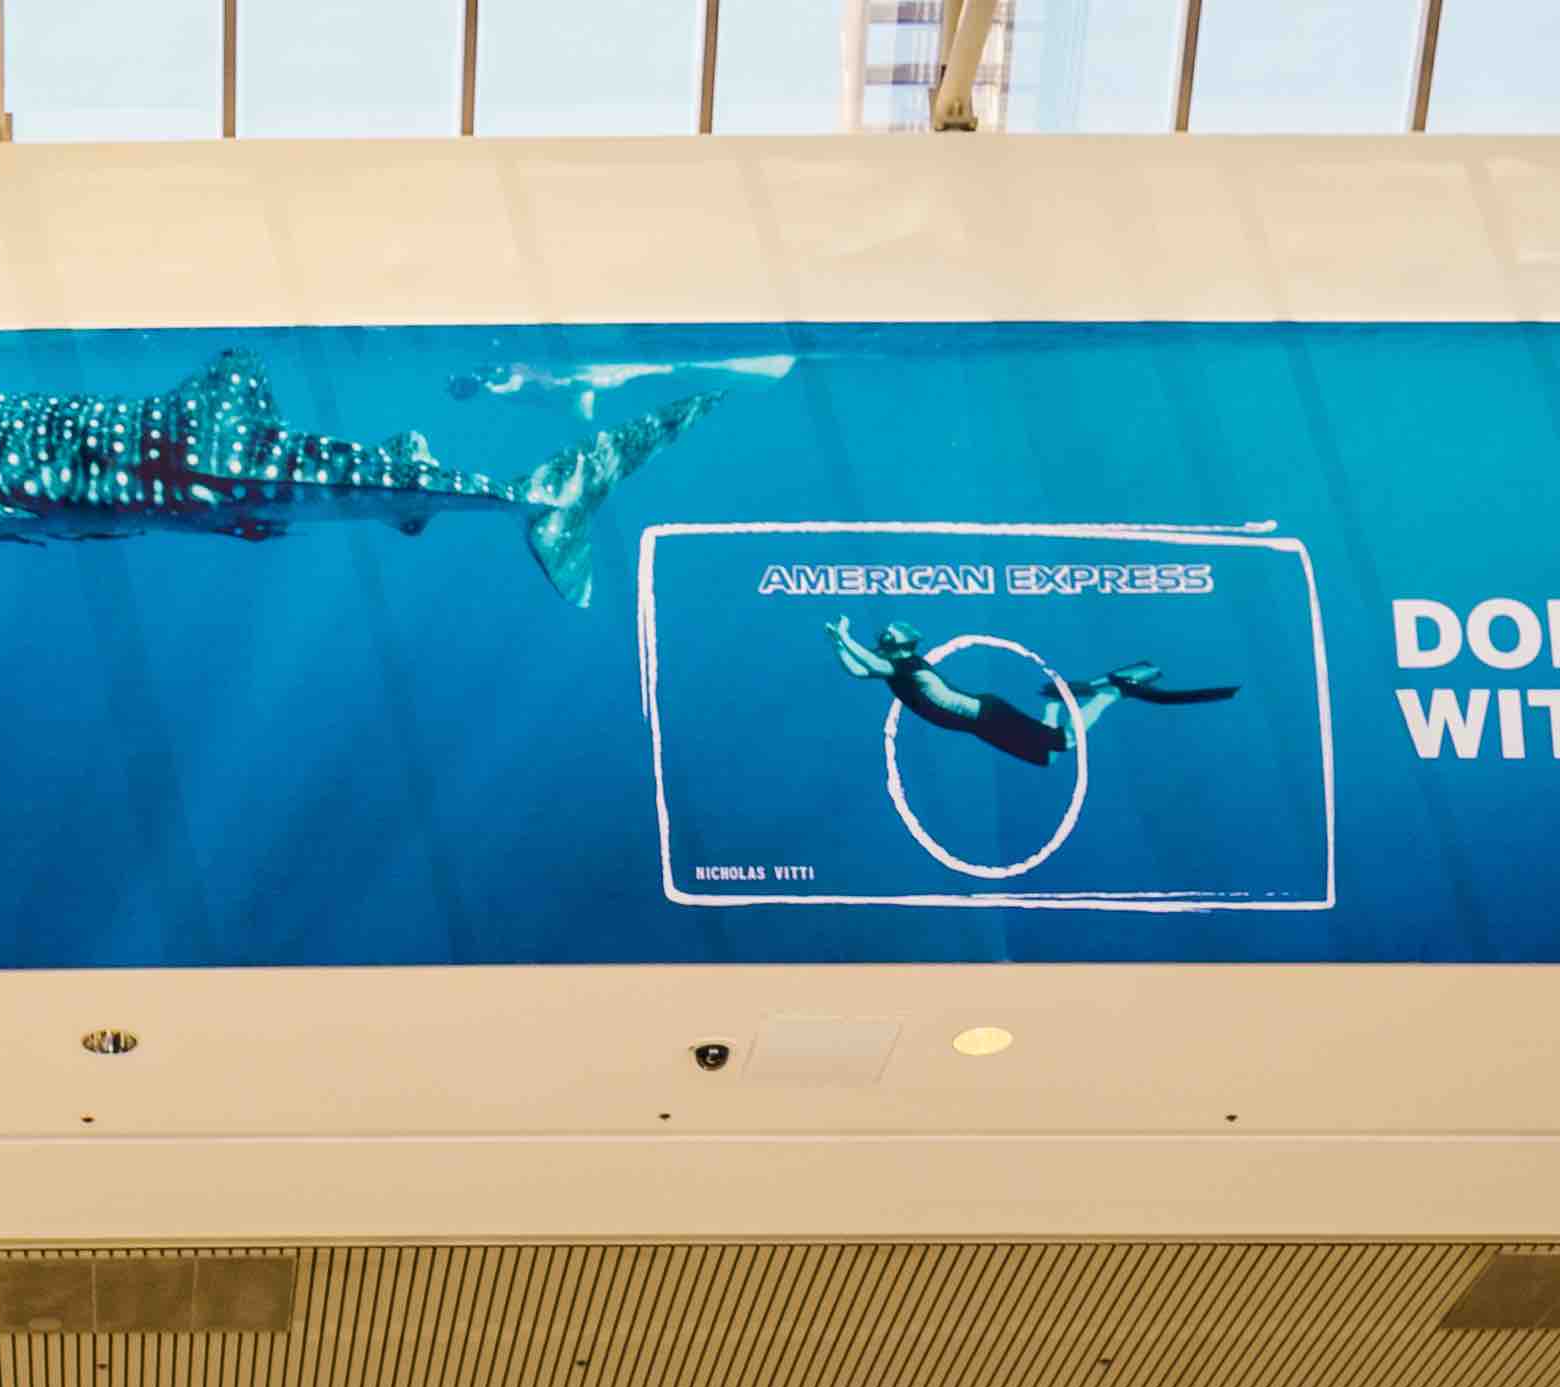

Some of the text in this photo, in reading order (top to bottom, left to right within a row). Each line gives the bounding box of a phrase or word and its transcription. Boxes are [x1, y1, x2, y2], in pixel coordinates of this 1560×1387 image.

[759, 565, 1214, 594] AMERICAN EXPRESS
[695, 866, 815, 880] NICHOLAS VITTI
